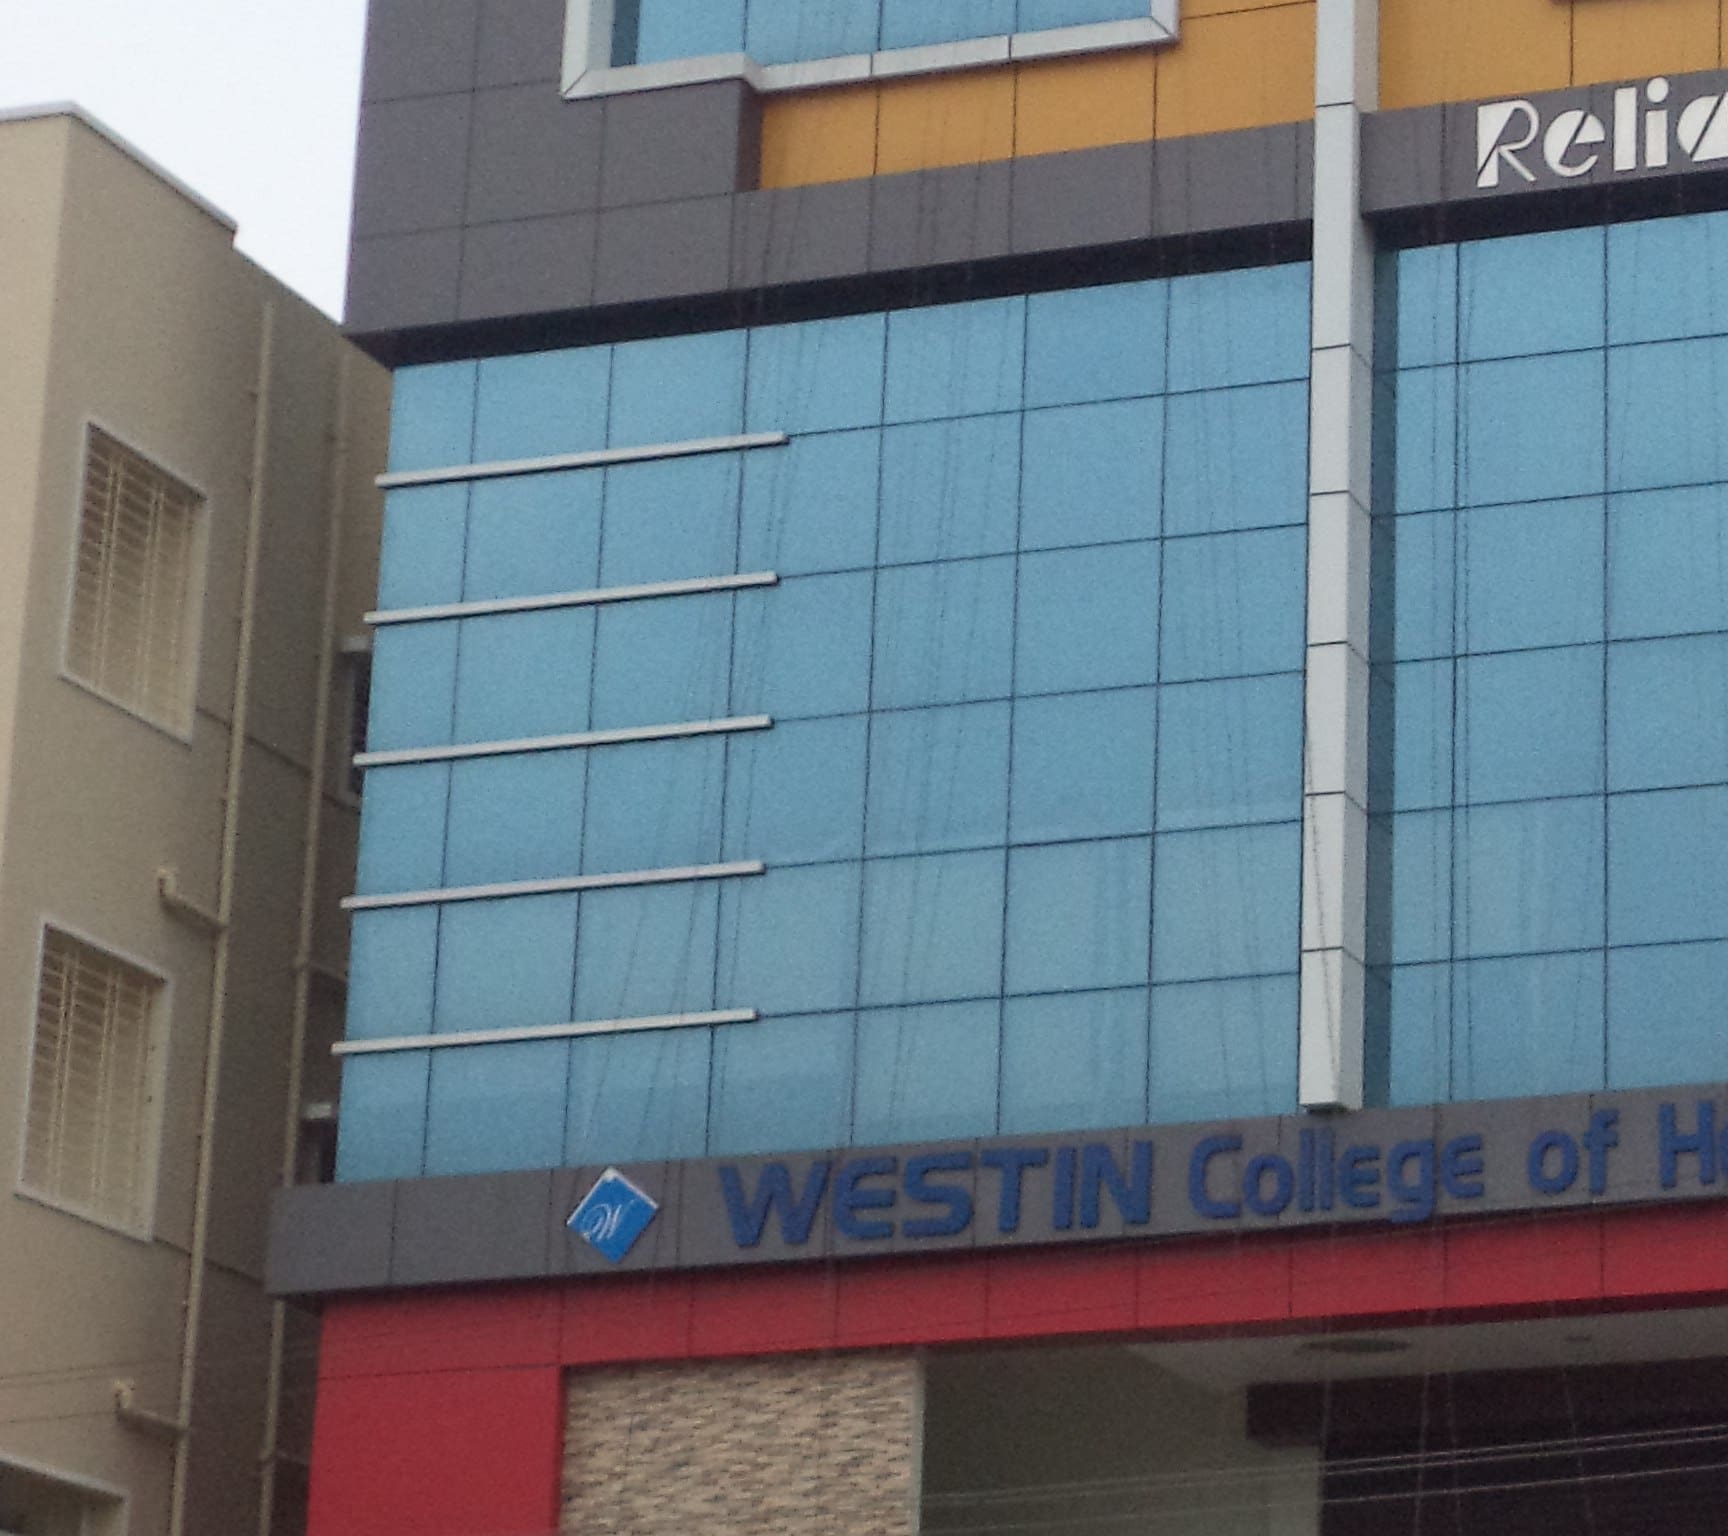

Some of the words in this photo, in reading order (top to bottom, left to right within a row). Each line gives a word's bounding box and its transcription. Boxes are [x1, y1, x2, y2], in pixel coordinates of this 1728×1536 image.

[718, 1140, 1153, 1248] WESTIN
[1187, 1129, 1486, 1224] College
[1526, 1106, 1620, 1197] of
